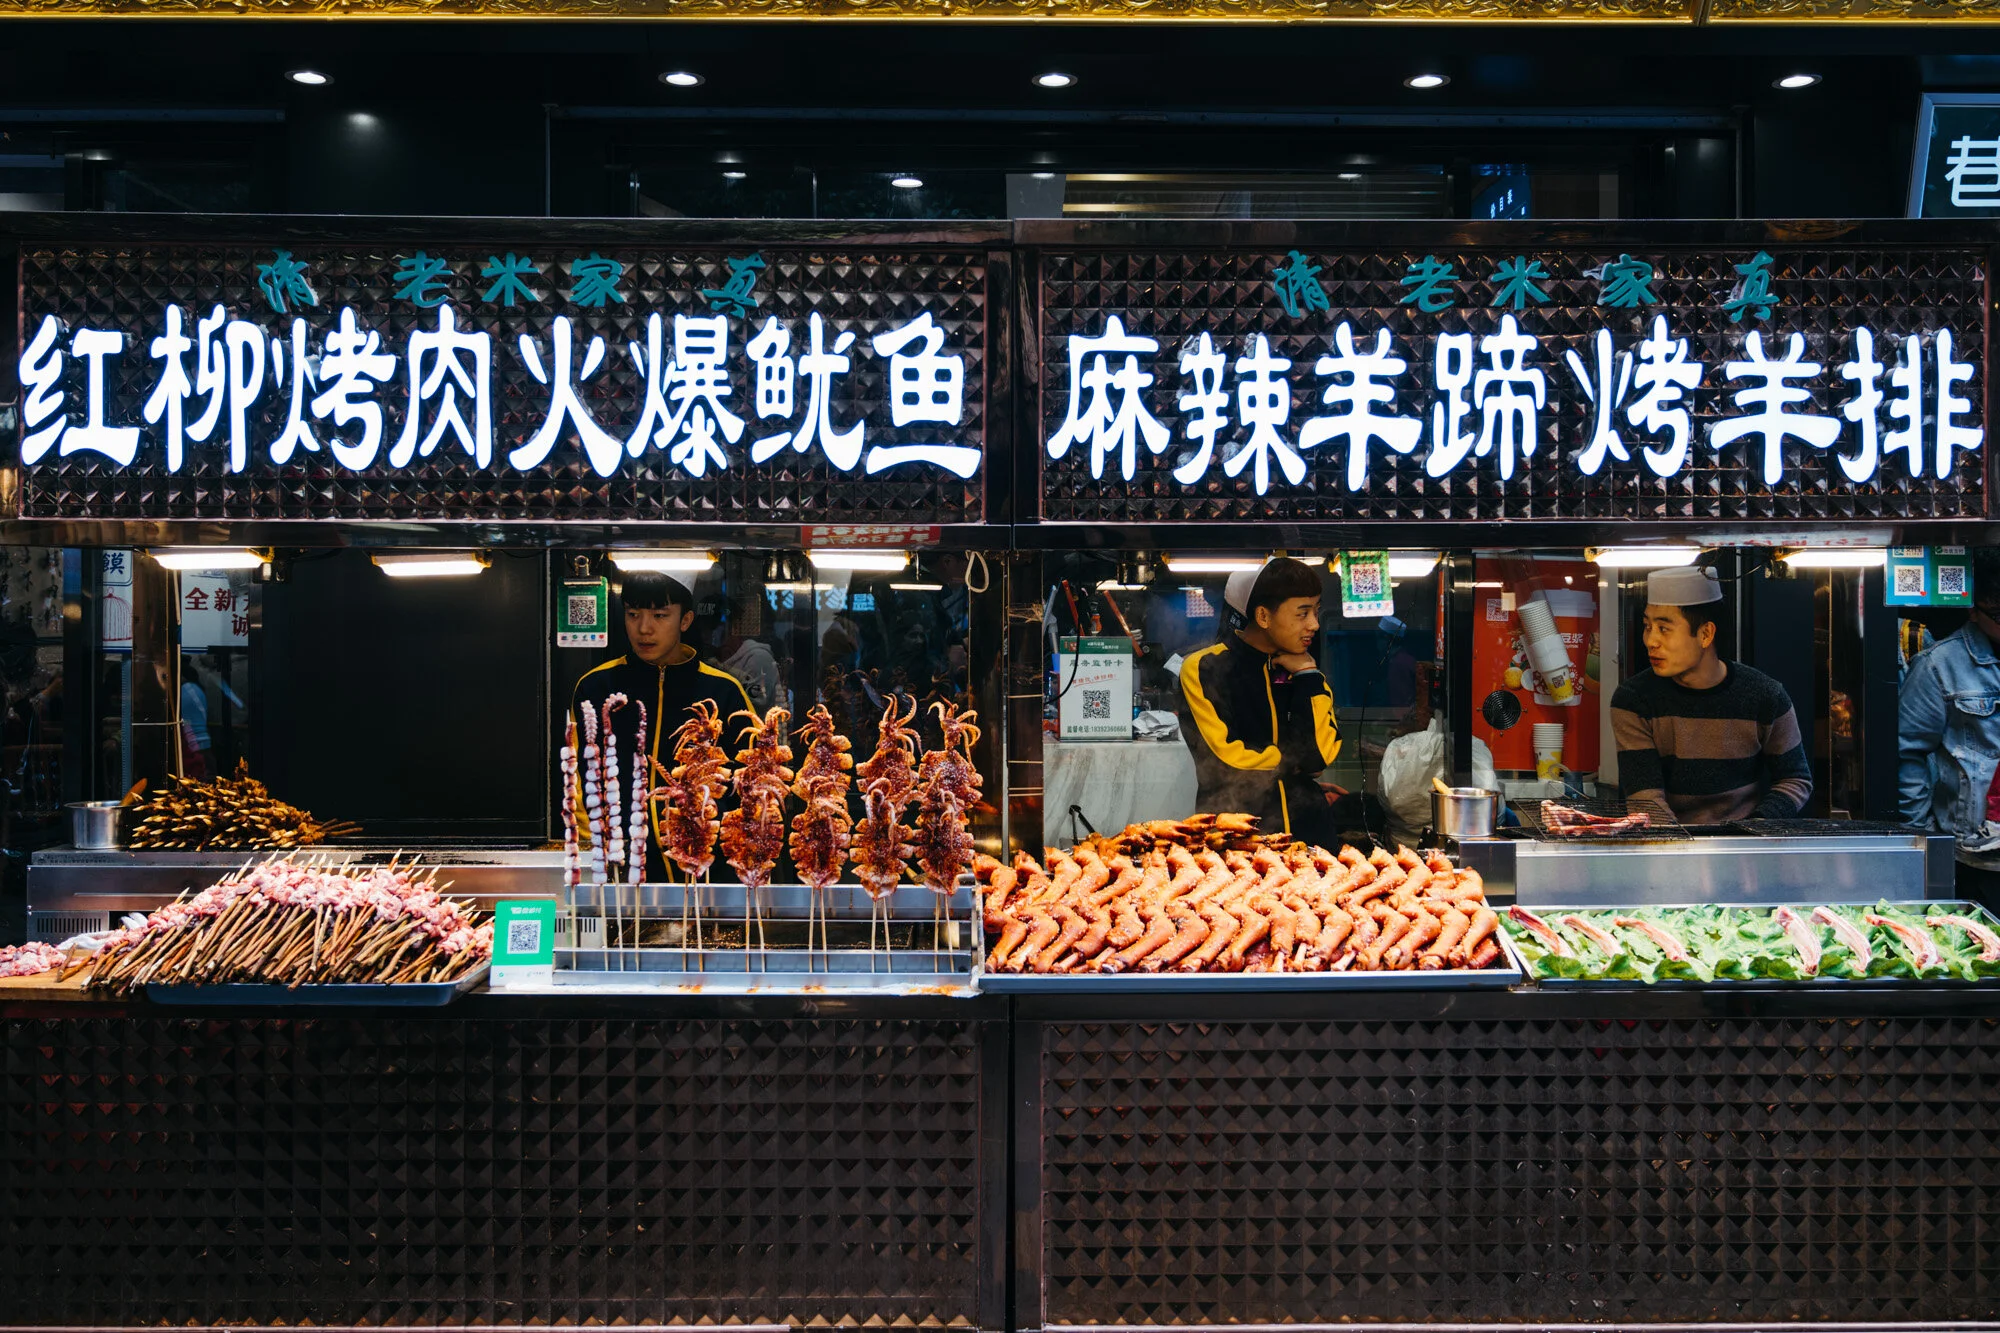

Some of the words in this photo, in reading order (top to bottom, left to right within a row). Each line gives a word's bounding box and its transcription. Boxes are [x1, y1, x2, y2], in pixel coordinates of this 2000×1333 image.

[18, 303, 982, 479] 红柳烤肉火爆鱿鱼
[1046, 314, 1984, 496] 麻辣羊蹄烤羊排
[185, 587, 248, 612] 全新
